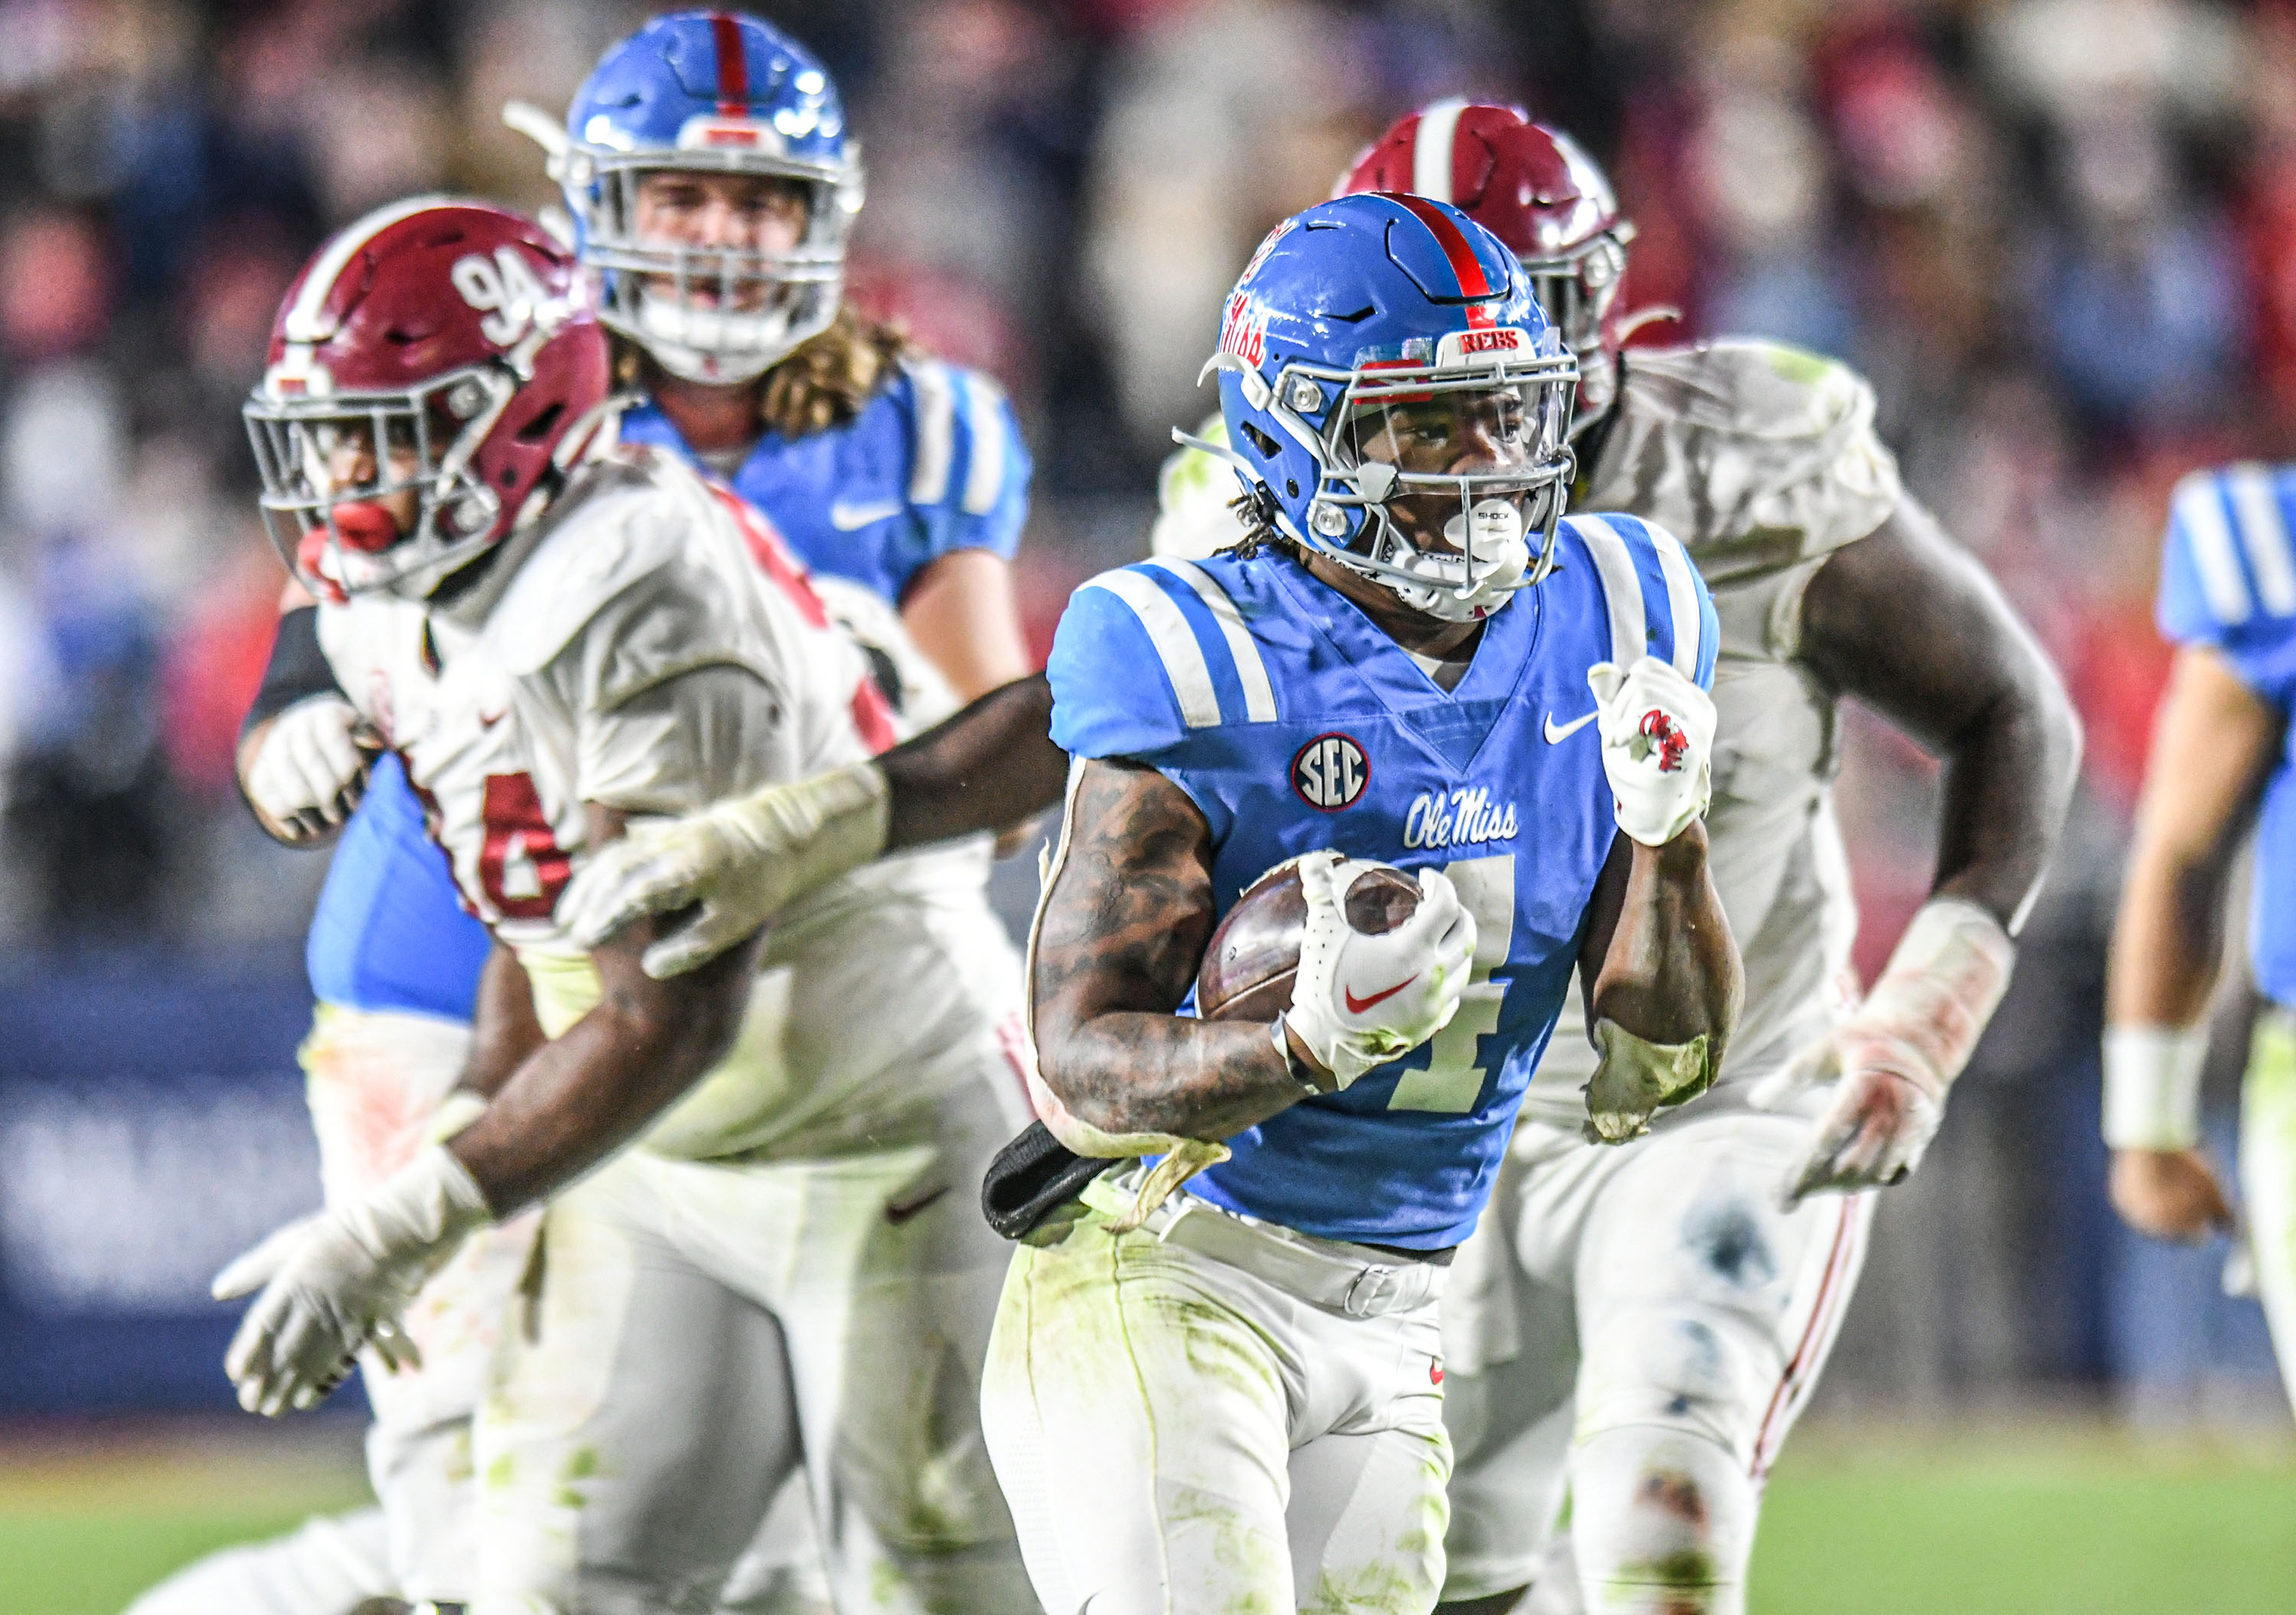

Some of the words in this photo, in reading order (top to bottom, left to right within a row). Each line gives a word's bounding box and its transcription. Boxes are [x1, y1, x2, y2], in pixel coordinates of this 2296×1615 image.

[451, 245, 554, 346] 94
[1459, 330, 1518, 354] REBS
[1300, 738, 1364, 807] SEC
[1404, 791, 1451, 849] Ole
[1450, 787, 1518, 844] Miss
